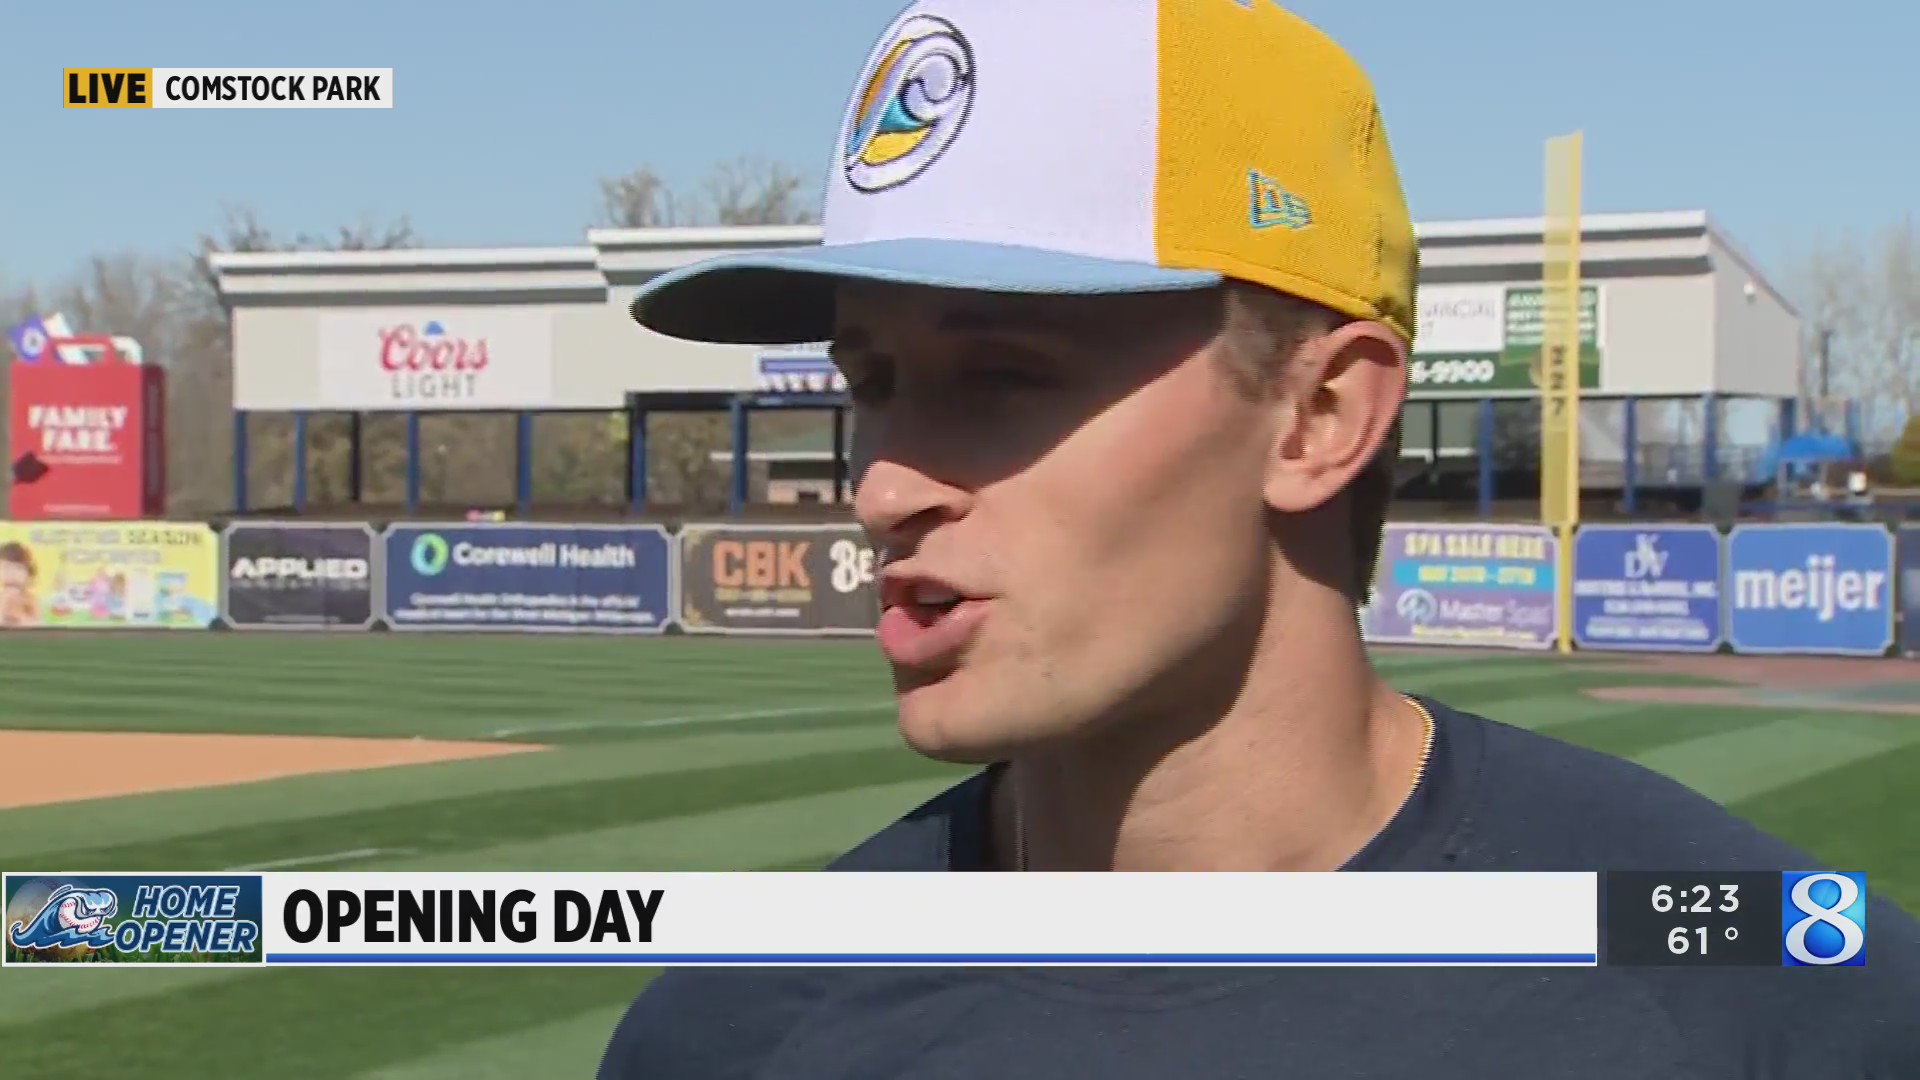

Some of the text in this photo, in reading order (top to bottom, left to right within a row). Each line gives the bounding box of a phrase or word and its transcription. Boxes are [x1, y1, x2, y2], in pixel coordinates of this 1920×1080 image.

[378, 324, 488, 371] Coors
[391, 374, 478, 398] LIGHT
[28, 405, 128, 429] FAMILY
[230, 555, 369, 580] APPLIED
[452, 541, 635, 569] Corewell Health
[713, 540, 812, 587] CBK
[1735, 555, 1885, 622] meijer
